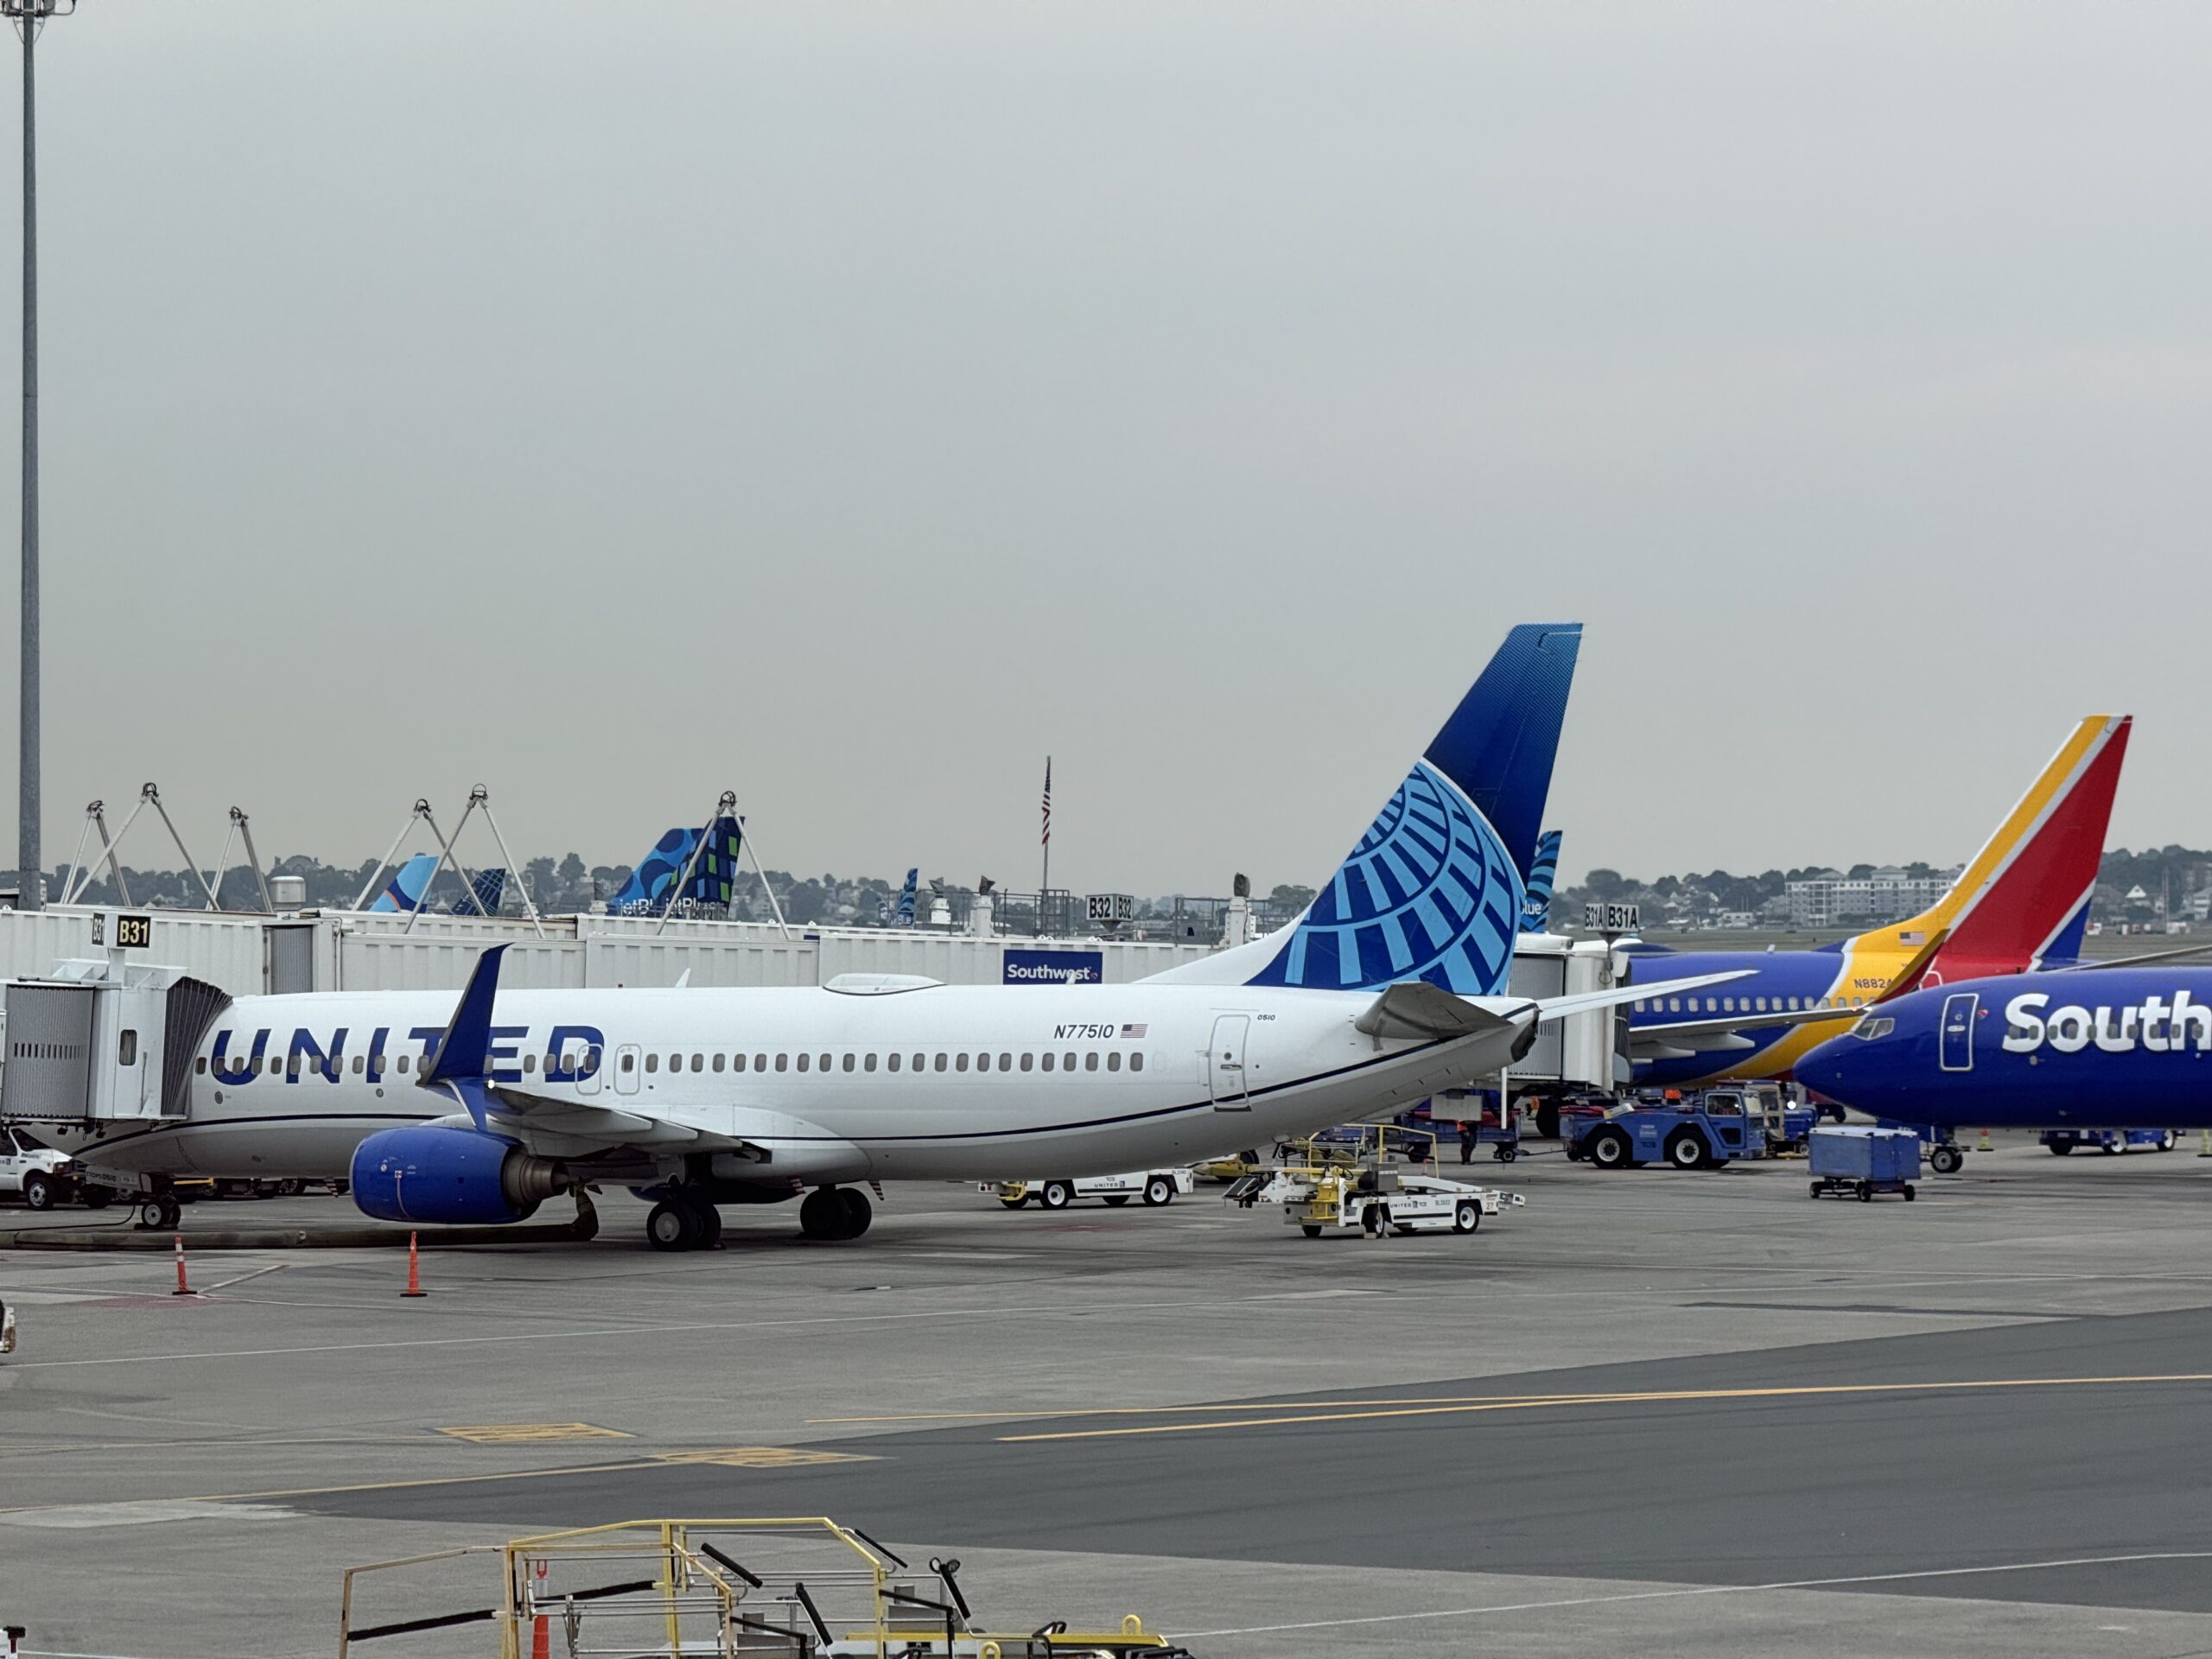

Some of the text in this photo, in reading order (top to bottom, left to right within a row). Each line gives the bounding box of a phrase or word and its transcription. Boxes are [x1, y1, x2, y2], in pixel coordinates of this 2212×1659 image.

[620, 898, 653, 916] jetBl
[1089, 897, 1111, 918] B32
[1117, 897, 1132, 919] B32
[1585, 905, 1603, 928] B31A
[1608, 906, 1638, 929] B31A
[92, 918, 105, 942] B31
[118, 920, 149, 944] B31
[1007, 964, 1091, 981] Southwest
[1053, 1024, 1115, 1039] N77510
[2002, 990, 2212, 1052] South
[1486, 1202, 1494, 1211] 27
